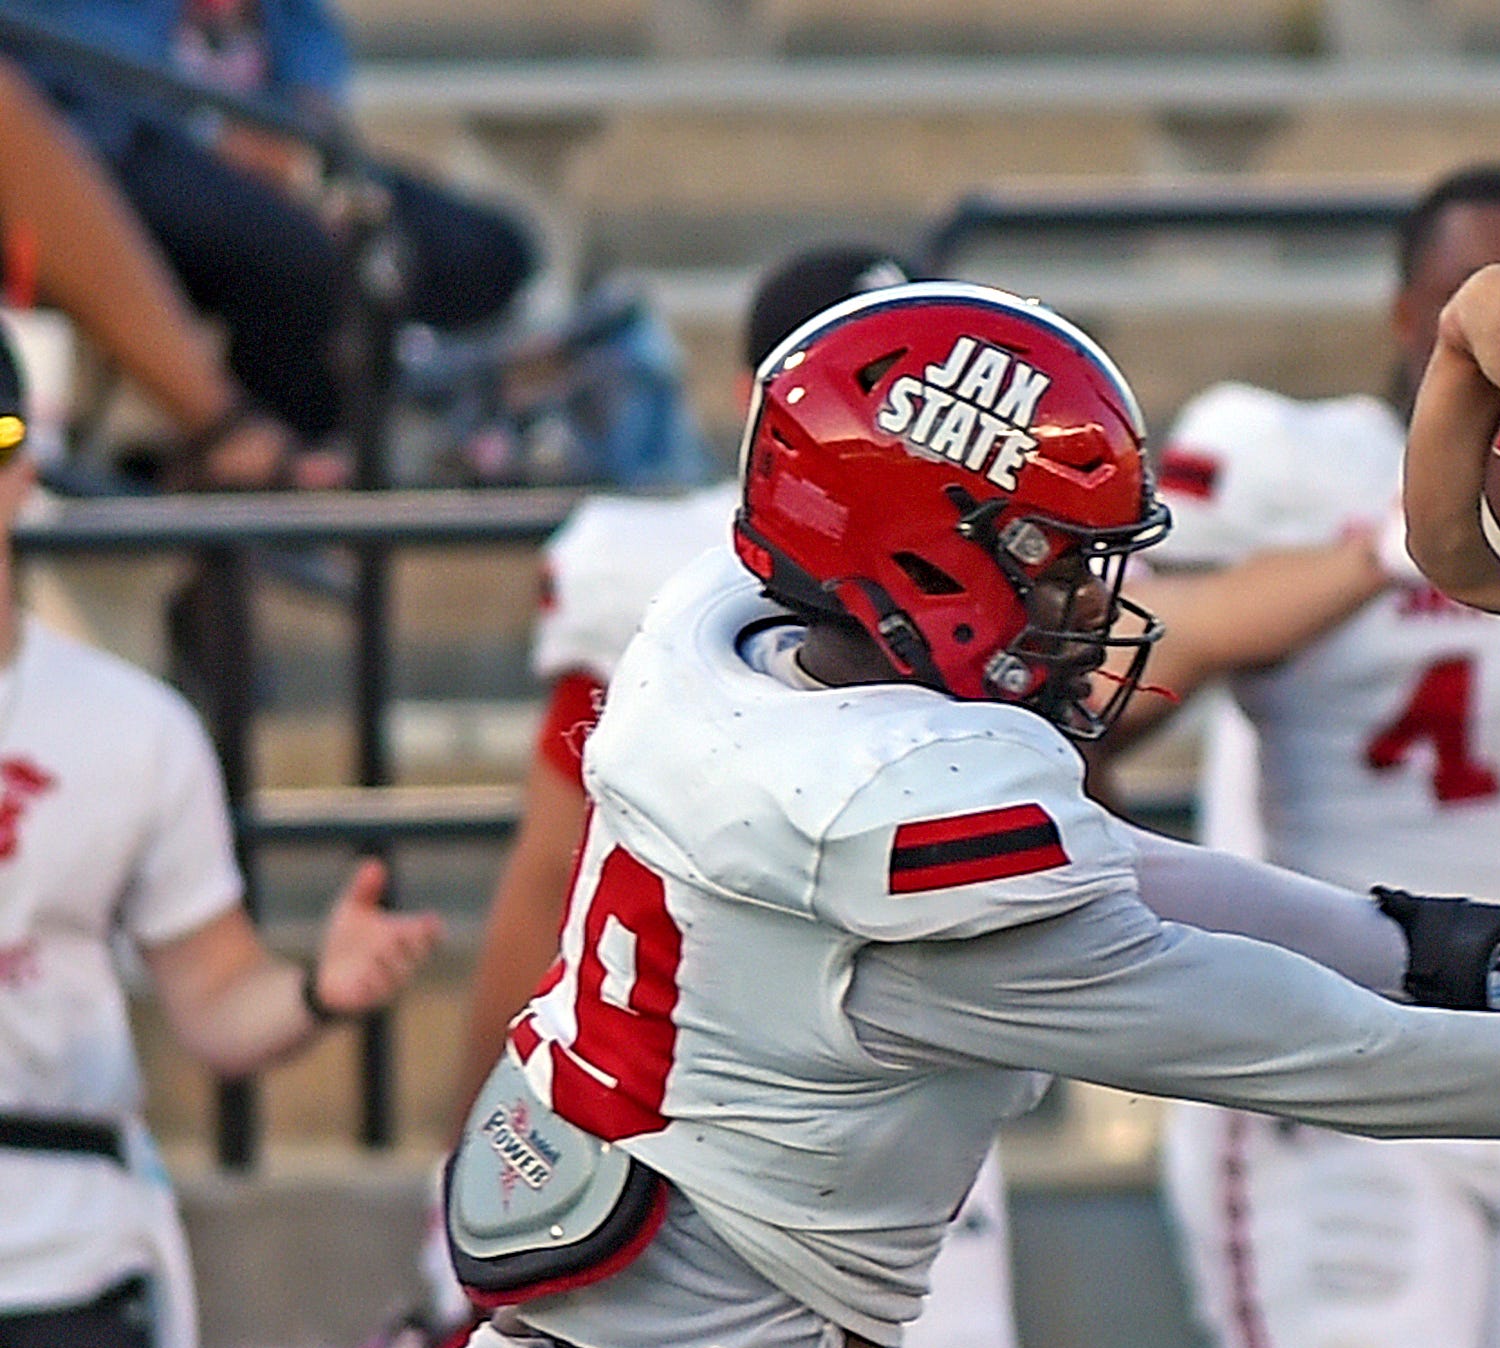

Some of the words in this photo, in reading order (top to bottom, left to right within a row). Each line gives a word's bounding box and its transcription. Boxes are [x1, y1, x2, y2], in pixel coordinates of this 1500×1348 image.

[925, 336, 1053, 427] JAX
[877, 376, 1039, 492] STATE
[482, 1107, 551, 1186] POWER
